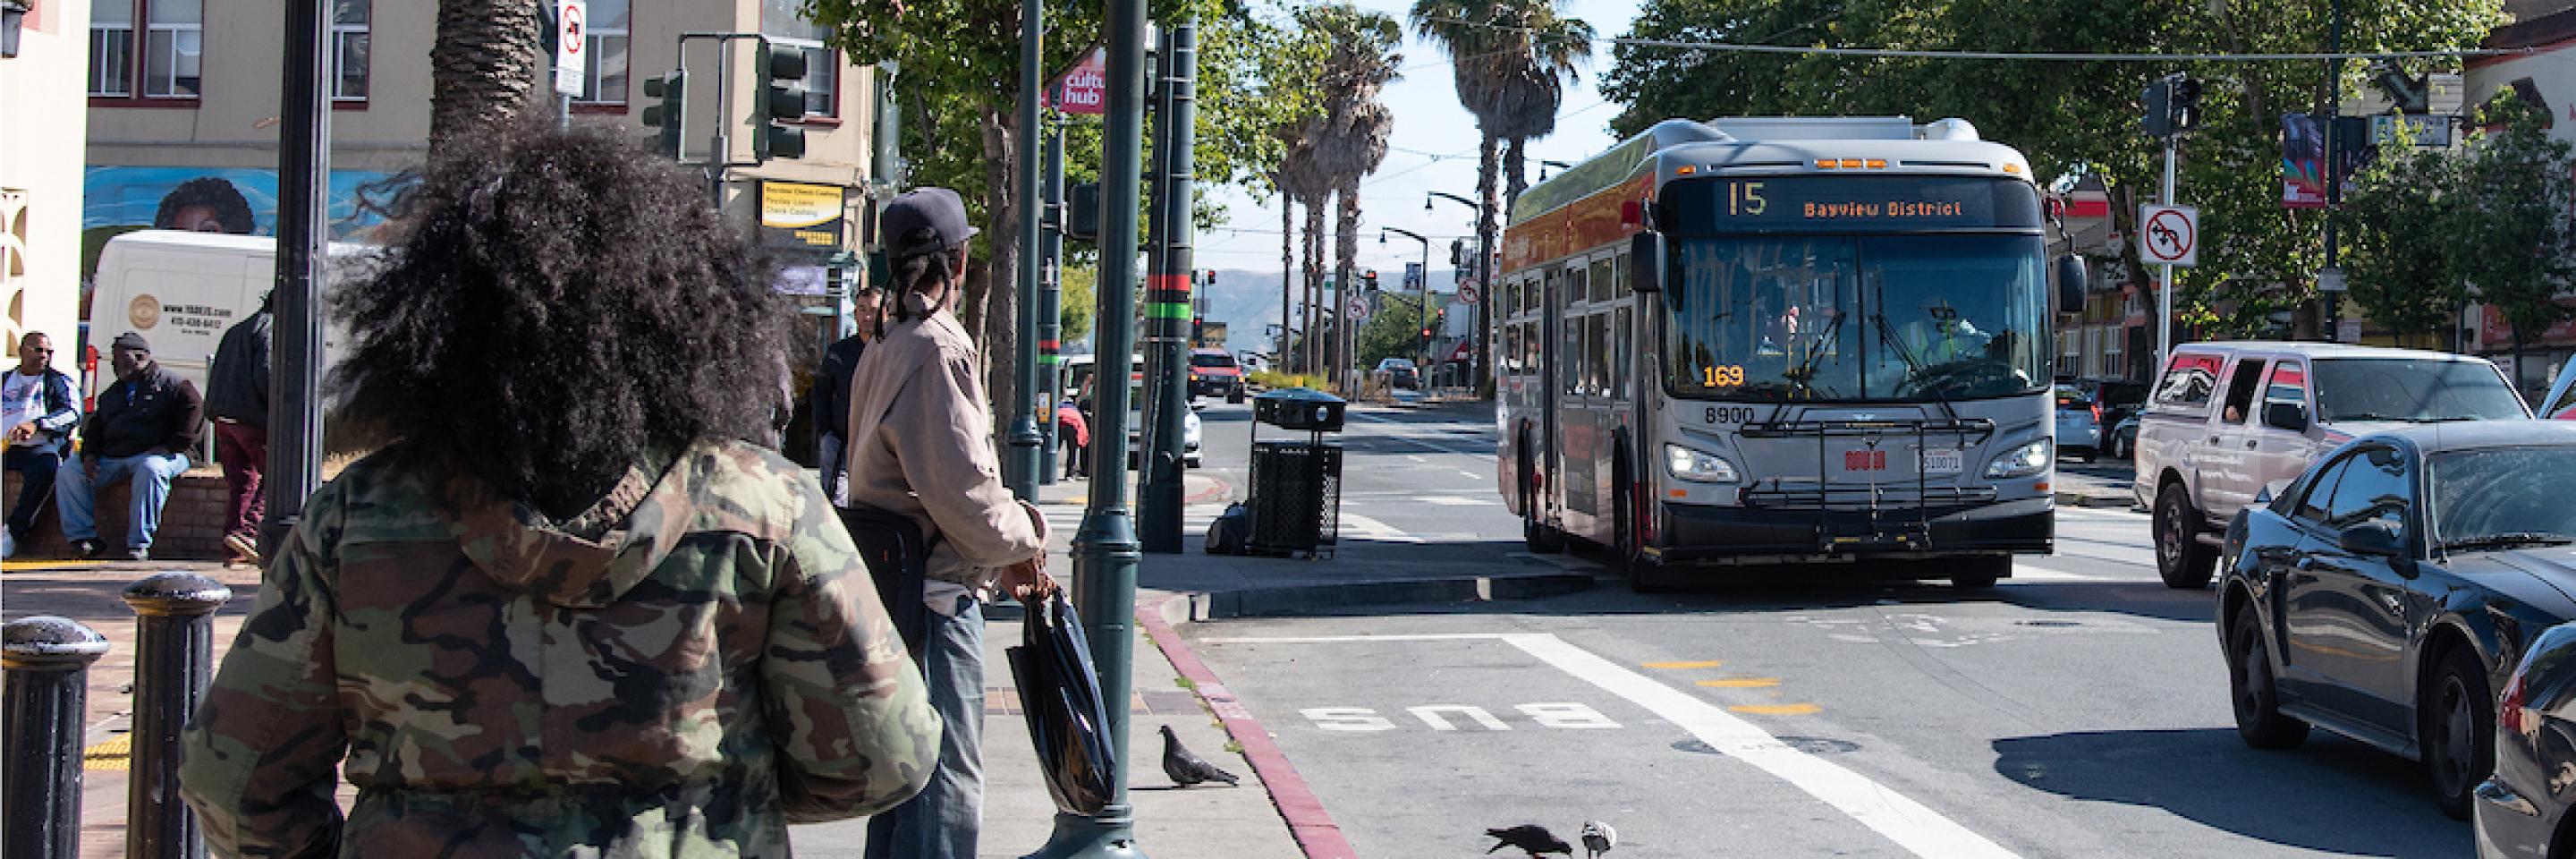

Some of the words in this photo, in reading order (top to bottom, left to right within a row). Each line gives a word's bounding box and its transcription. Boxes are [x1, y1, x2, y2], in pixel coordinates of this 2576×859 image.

[1065, 87, 1099, 104] hub
[1729, 182, 1766, 216] 15
[1804, 202, 1879, 217] Bayview
[1888, 201, 1962, 216] District
[1704, 365, 1744, 387] 169
[1706, 406, 1755, 424] 8900
[1919, 456, 1960, 470] 510071
[1297, 702, 1624, 732] BUS
